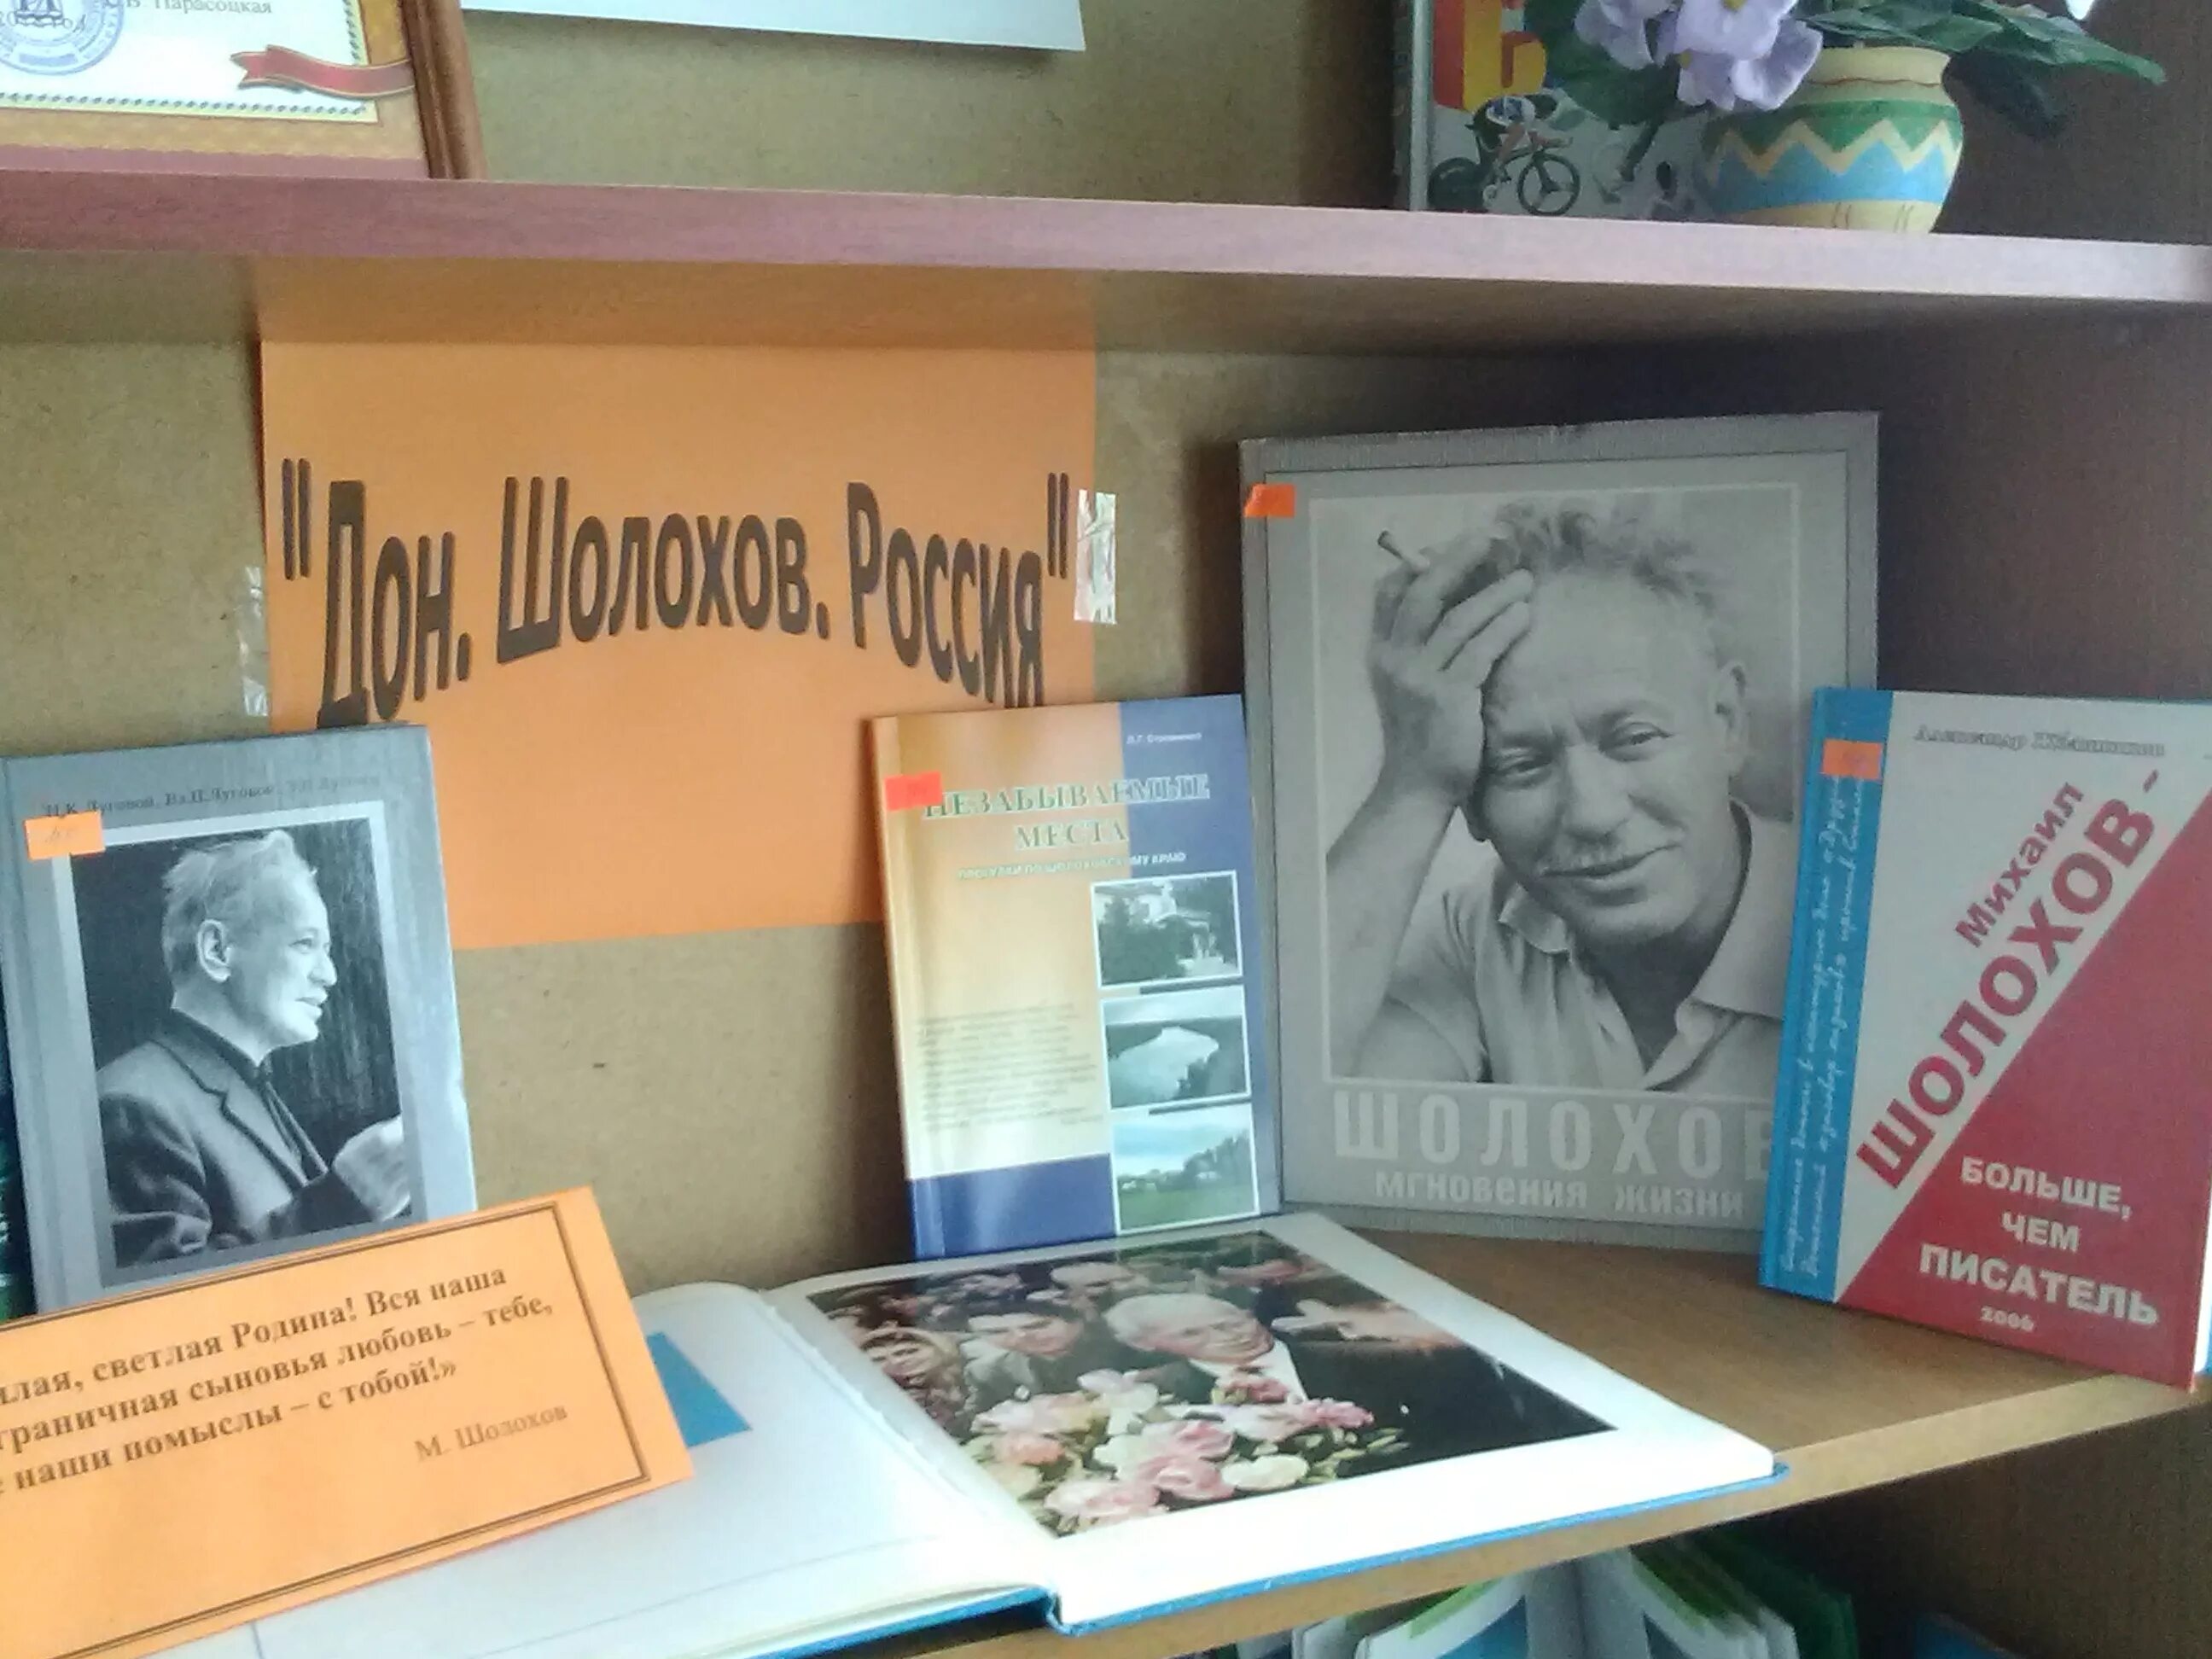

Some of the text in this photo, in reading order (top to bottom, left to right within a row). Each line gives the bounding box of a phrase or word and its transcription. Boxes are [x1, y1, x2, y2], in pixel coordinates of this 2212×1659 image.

[497, 474, 830, 664] Шолохов.
[1016, 818, 1130, 850] МЕСТА
[1955, 783, 2084, 948] Михаил
[1856, 799, 2155, 1190] ШОЛОХОВ
[1960, 1155, 2132, 1220] БОЛЬШЕ,
[2001, 1210, 2080, 1254] ЧЕМ
[92, 1335, 224, 1382] светлая
[230, 1296, 358, 1349] Родина!
[365, 1289, 422, 1317] Вся
[429, 1268, 507, 1301] наша
[1918, 1243, 2159, 1327] ПИСАТЕЛЬ
[189, 1351, 329, 1401] сыновья
[337, 1323, 452, 1365] любовь
[483, 1295, 553, 1327] тебе,
[15, 1448, 113, 1490] наши
[123, 1404, 282, 1463] помыслы
[317, 1391, 334, 1410] с
[340, 1356, 457, 1404] тобой!»
[414, 1405, 569, 1462] М. Шолохов
